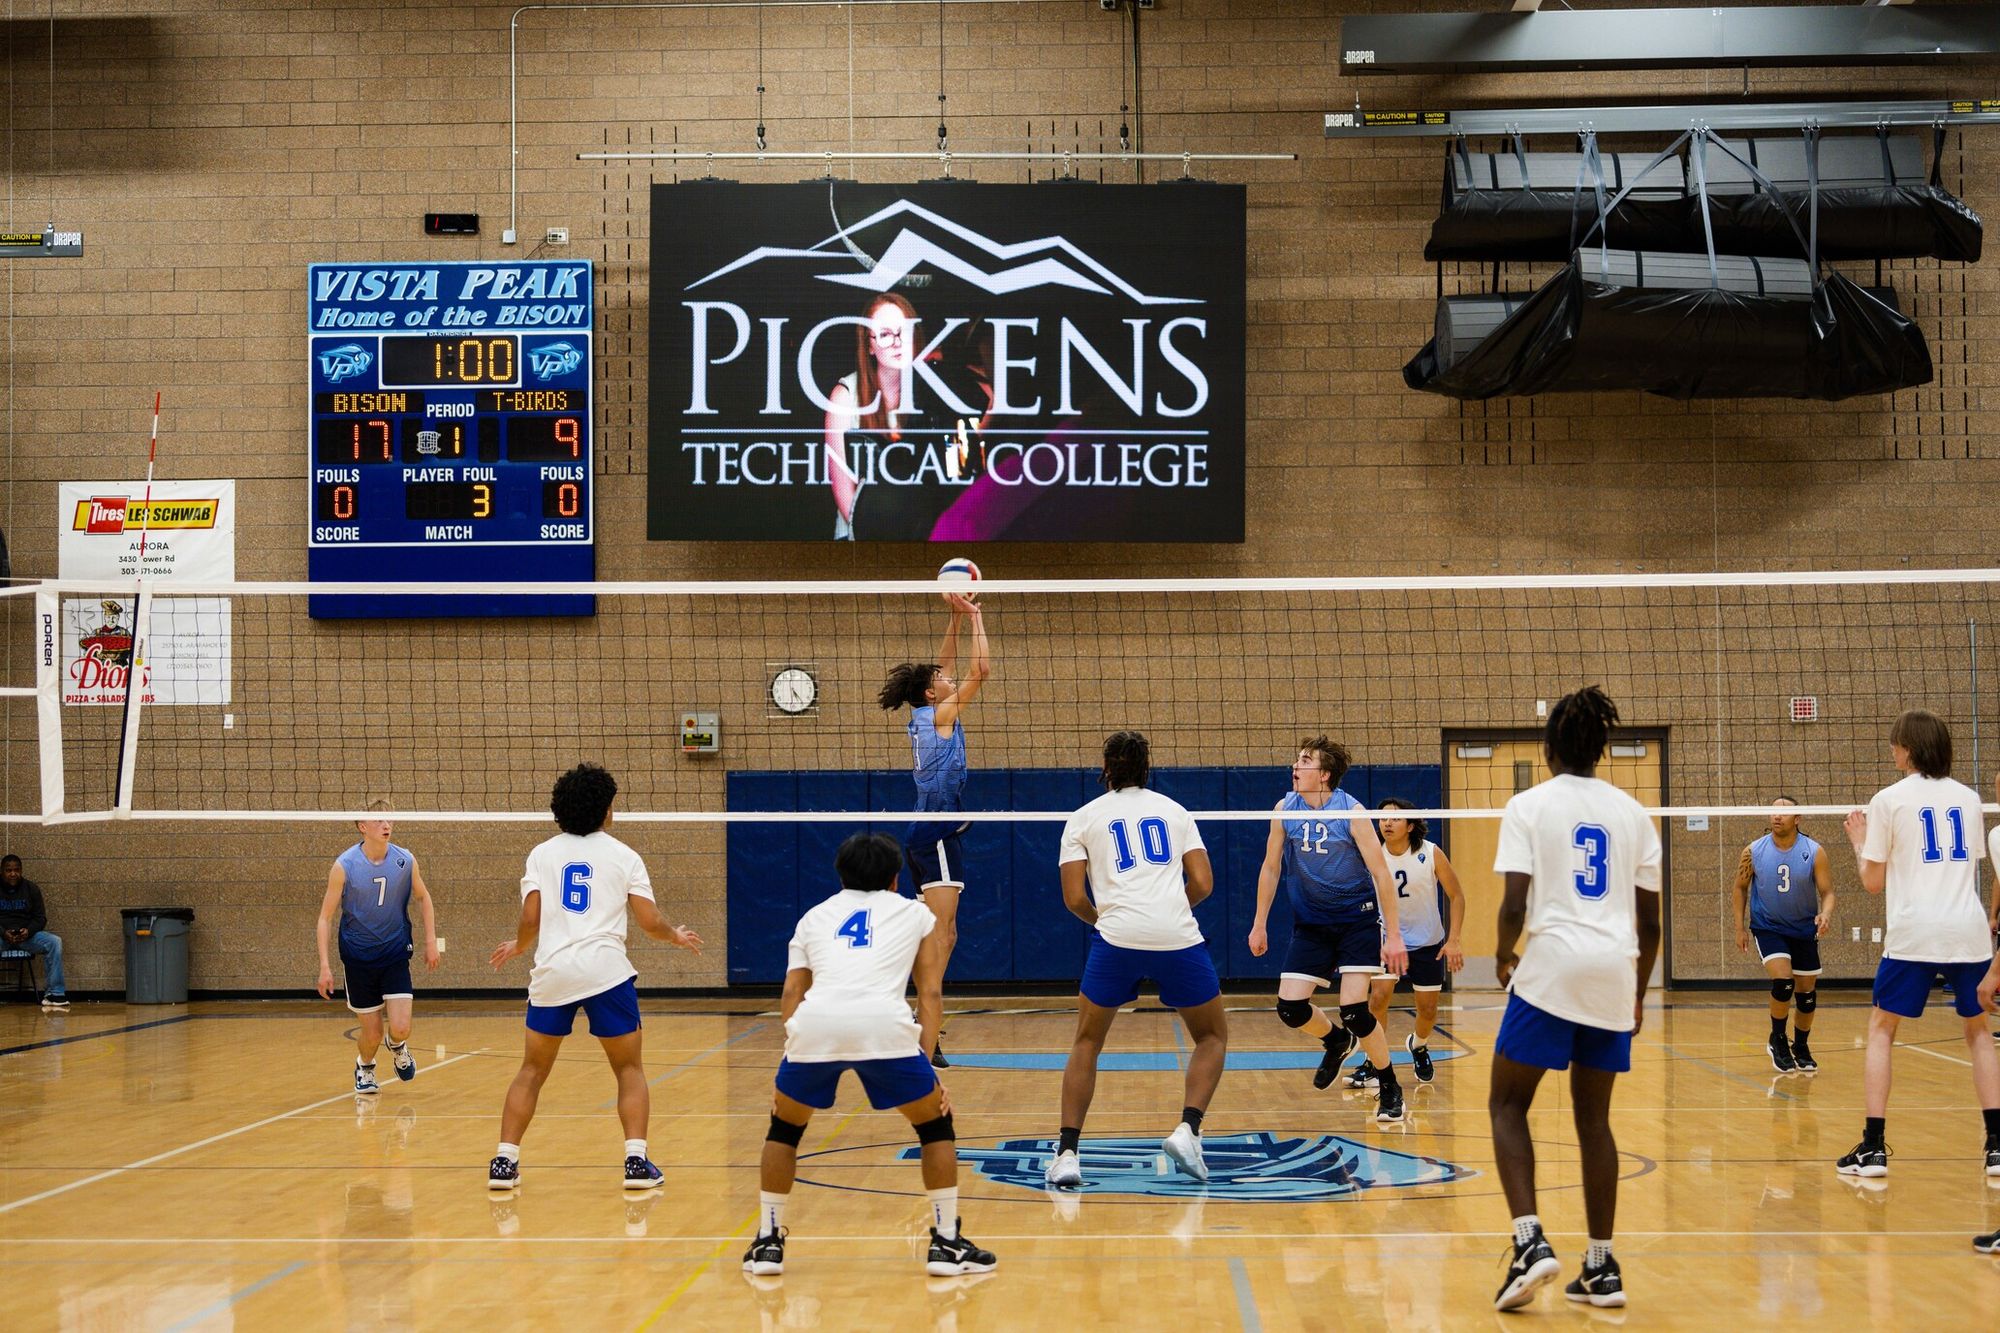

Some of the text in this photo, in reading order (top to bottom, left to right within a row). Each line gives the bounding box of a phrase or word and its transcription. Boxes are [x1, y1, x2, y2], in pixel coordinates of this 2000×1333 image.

[315, 267, 586, 301] VISTA PEAK
[316, 304, 586, 327] Home of the BISON
[436, 340, 512, 381] 1:00
[681, 300, 1209, 418] PICKENS
[333, 393, 406, 413] BISON
[426, 404, 474, 418] PERIOD
[493, 391, 568, 411] T-BIRDS
[354, 420, 389, 460] 17
[454, 426, 460, 454] 1
[554, 418, 578, 457] 9
[316, 470, 360, 483] FOULS
[403, 468, 497, 482] PLAYER FOUL
[540, 466, 584, 480] FOULS
[681, 441, 1209, 487] TECHNICAL COLLEGE
[91, 502, 211, 525] Tires LES SCHWAB
[334, 486, 353, 518] 0
[472, 484, 490, 517] 3
[558, 483, 577, 516] 0
[316, 527, 360, 541] SCORE
[425, 526, 473, 539] MATCH
[540, 524, 584, 538] SCORE
[129, 542, 170, 551] AURORA
[66, 694, 89, 703] PIZZA
[96, 694, 126, 703] SALADS
[1107, 816, 1173, 874] 10
[1300, 821, 1329, 855] 12
[1918, 806, 1969, 864] 11
[1571, 821, 1610, 901] 3
[372, 876, 387, 907] 7
[560, 861, 593, 915] 6
[1394, 869, 1410, 898] 2
[1777, 864, 1791, 894] 3
[834, 908, 873, 950] 4
